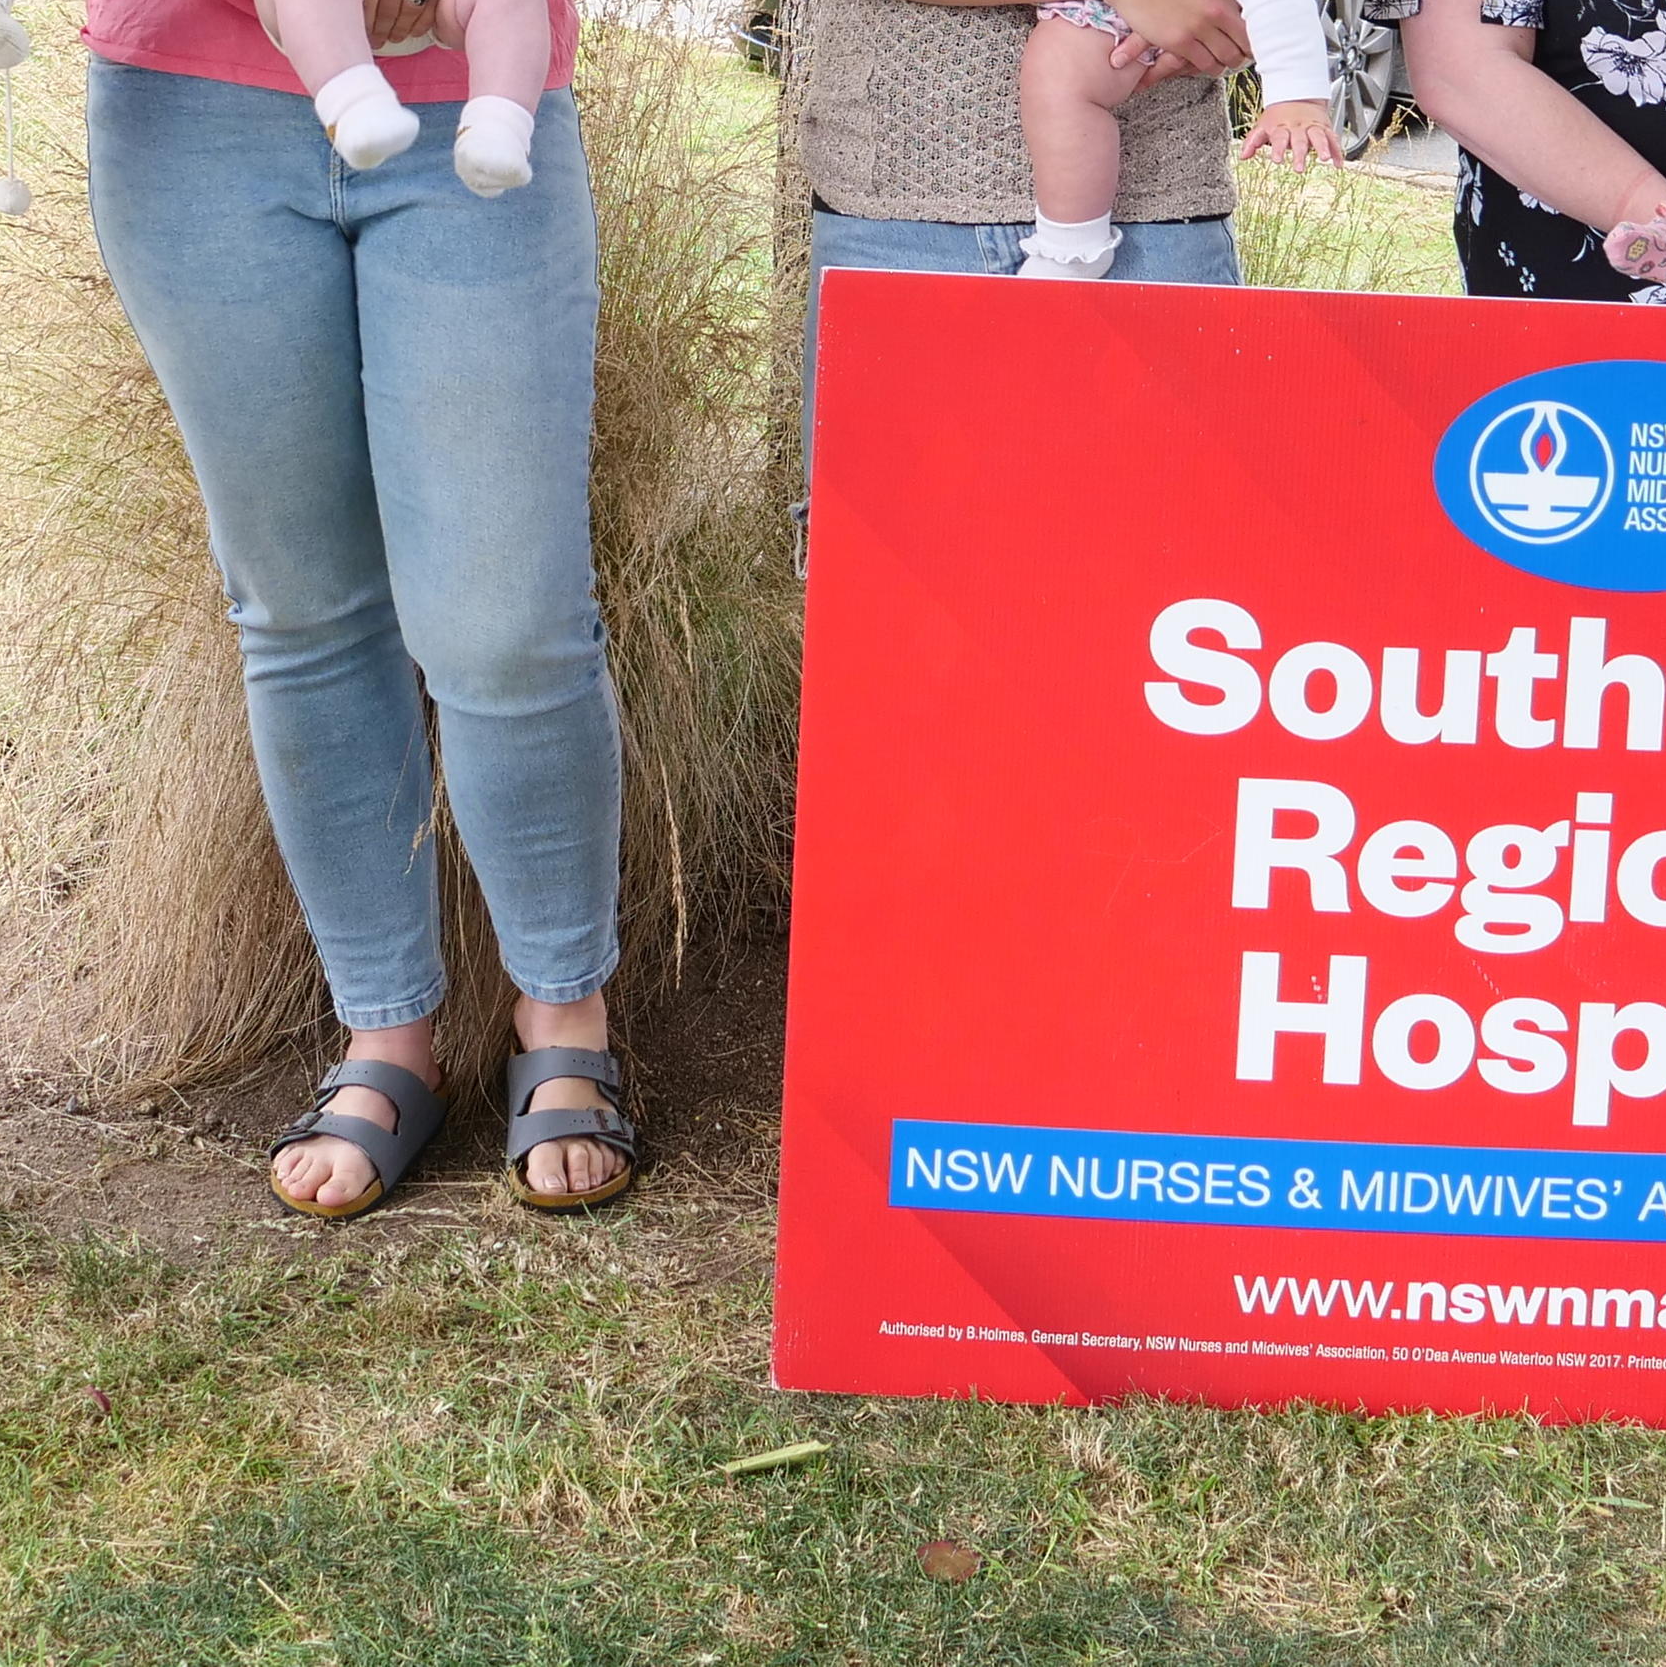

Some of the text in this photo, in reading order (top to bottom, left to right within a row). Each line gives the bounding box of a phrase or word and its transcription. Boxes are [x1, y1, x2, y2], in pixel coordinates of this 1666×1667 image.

[1143, 598, 1666, 752] South
[906, 1147, 1033, 1194] NSW
[1049, 1155, 1271, 1207] NURSES
[1287, 1167, 1323, 1209] &
[1340, 1169, 1623, 1221] MIDWIVES'
[879, 1320, 945, 1338] Authorised
[948, 1325, 963, 1341] by
[966, 1325, 1028, 1344] B.Holmes,
[1031, 1329, 1078, 1346] General
[1081, 1332, 1143, 1351] Secretary,
[1145, 1335, 1176, 1351] NSW
[1179, 1337, 1222, 1353] Nurses
[1224, 1340, 1249, 1354] and
[1315, 1343, 1389, 1361] Association,
[1392, 1346, 1409, 1361] 50
[1451, 1349, 1497, 1364] Avenue
[1499, 1350, 1554, 1366] Waterloo
[1556, 1352, 1587, 1367] NSW
[1589, 1354, 1624, 1368] 2017.
